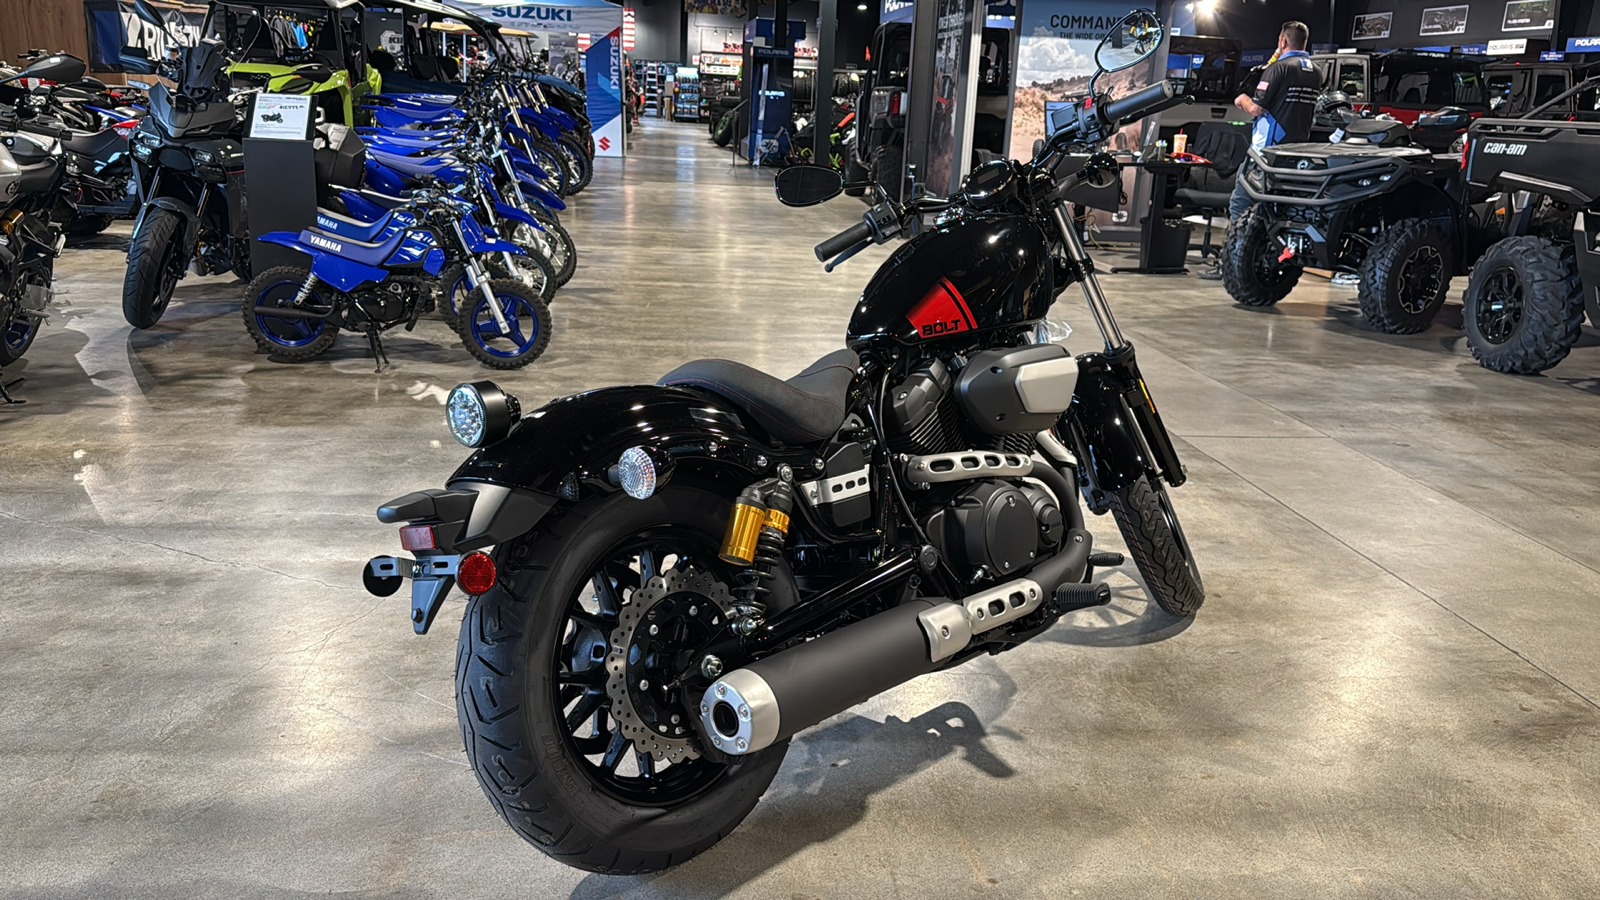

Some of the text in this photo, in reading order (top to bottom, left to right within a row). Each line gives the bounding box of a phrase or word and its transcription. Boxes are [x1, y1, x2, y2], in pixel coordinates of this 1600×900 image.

[491, 6, 572, 22] SUZUKI
[1075, 32, 1093, 40] WIDE
[758, 48, 789, 56] POLARIS
[610, 36, 620, 89] SUZUKI
[1483, 142, 1528, 156] can-am
[310, 235, 342, 253] YAMAHA
[922, 319, 961, 336] BOLT
